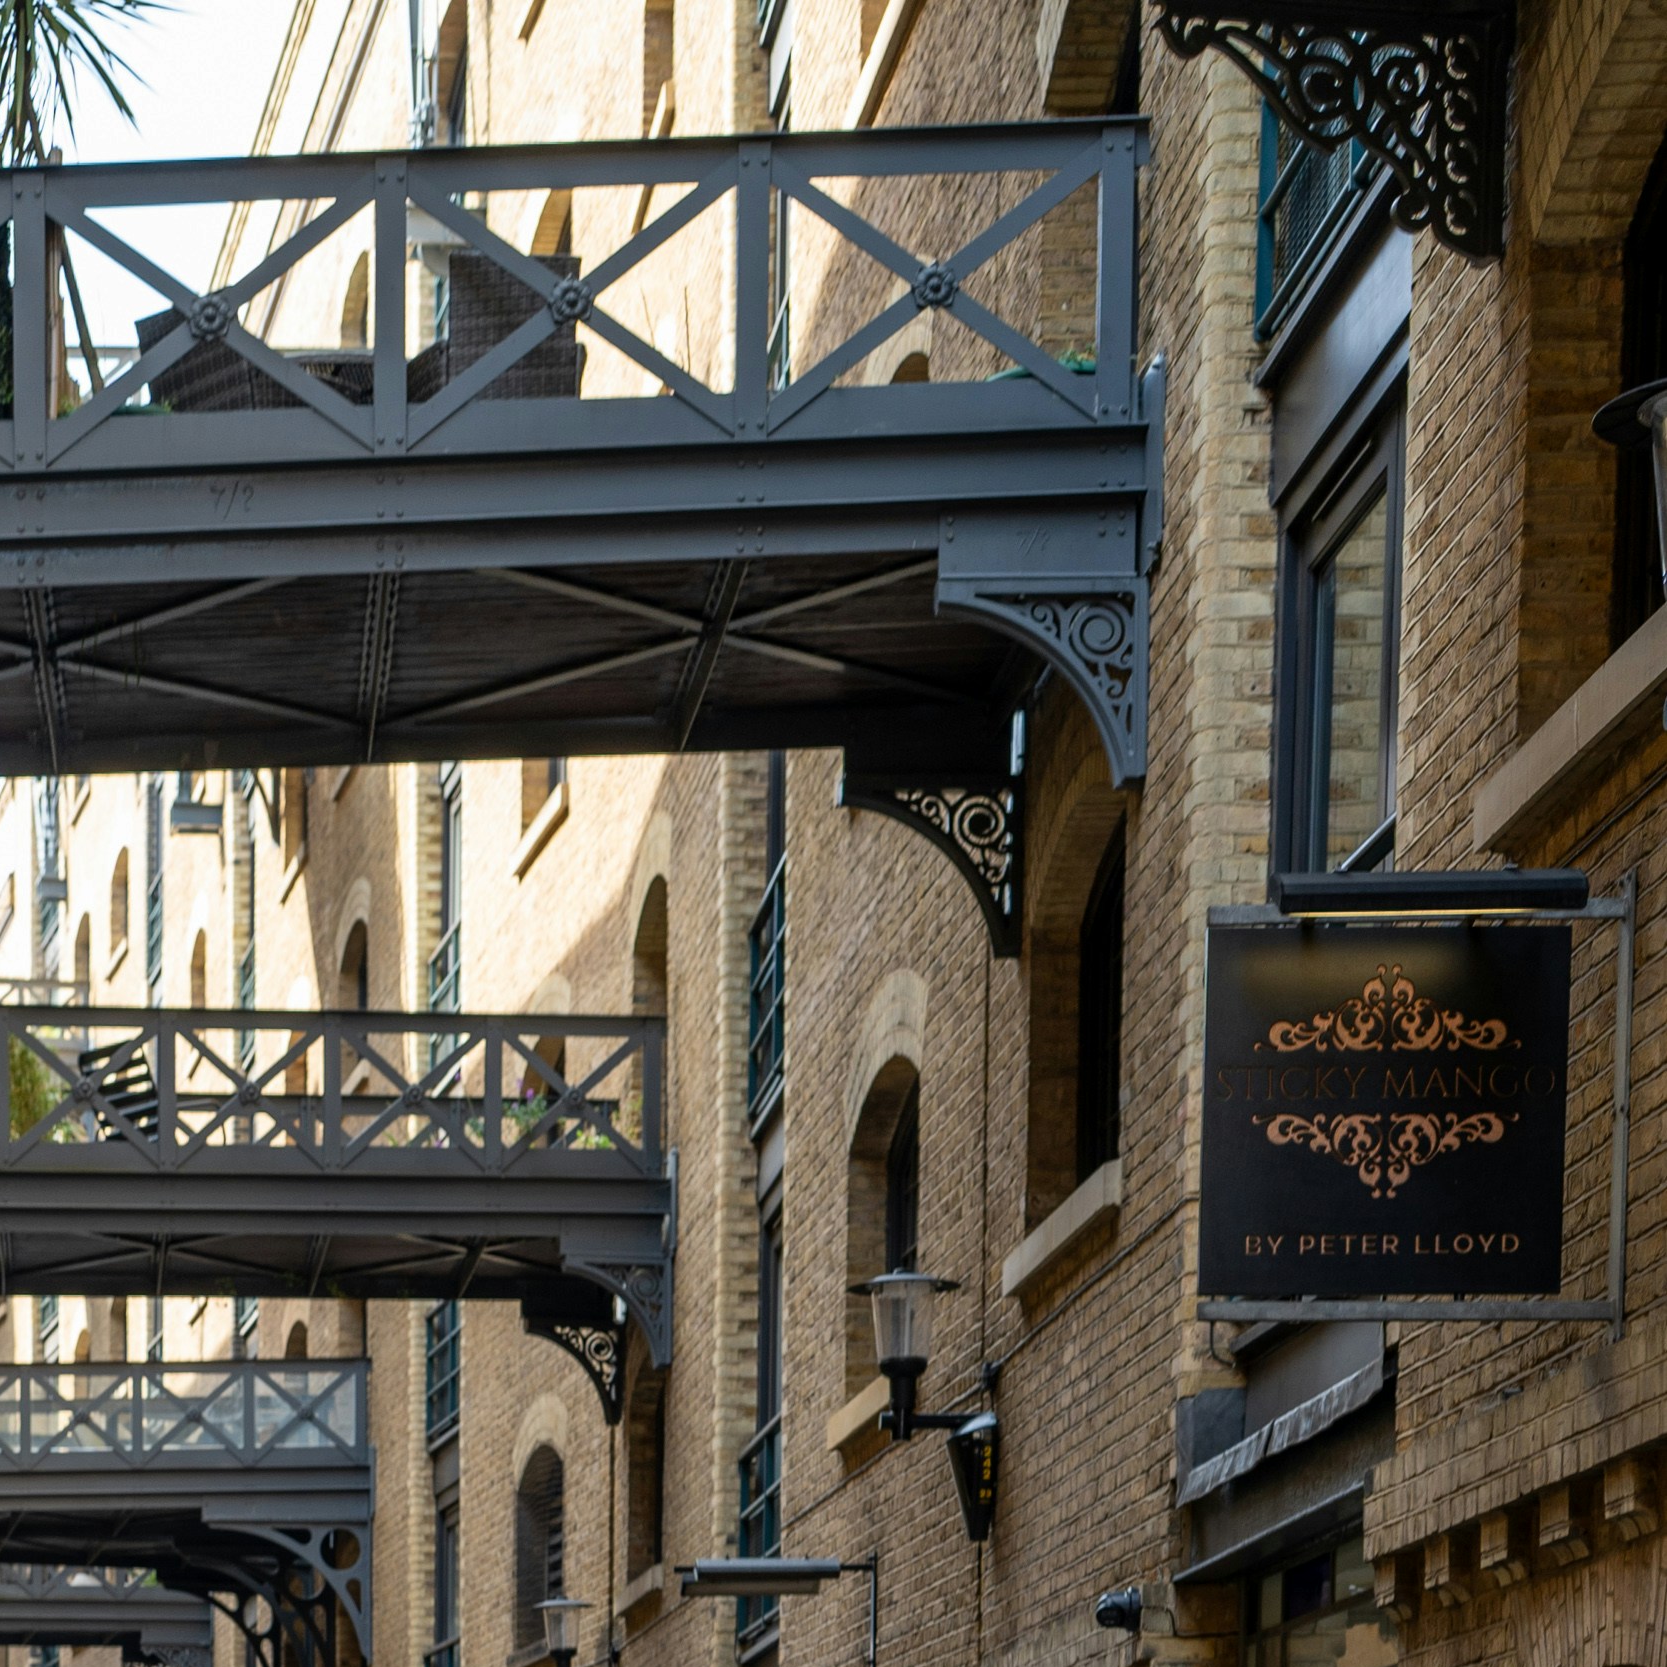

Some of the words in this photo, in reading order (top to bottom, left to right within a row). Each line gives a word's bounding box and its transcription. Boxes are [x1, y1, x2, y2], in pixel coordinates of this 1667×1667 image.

[1217, 1064, 1368, 1102] STICKY
[1383, 1064, 1556, 1099] MANGO
[1244, 1233, 1284, 1256] BY
[1298, 1233, 1399, 1256] PETER
[1414, 1232, 1521, 1255] LLOYD
